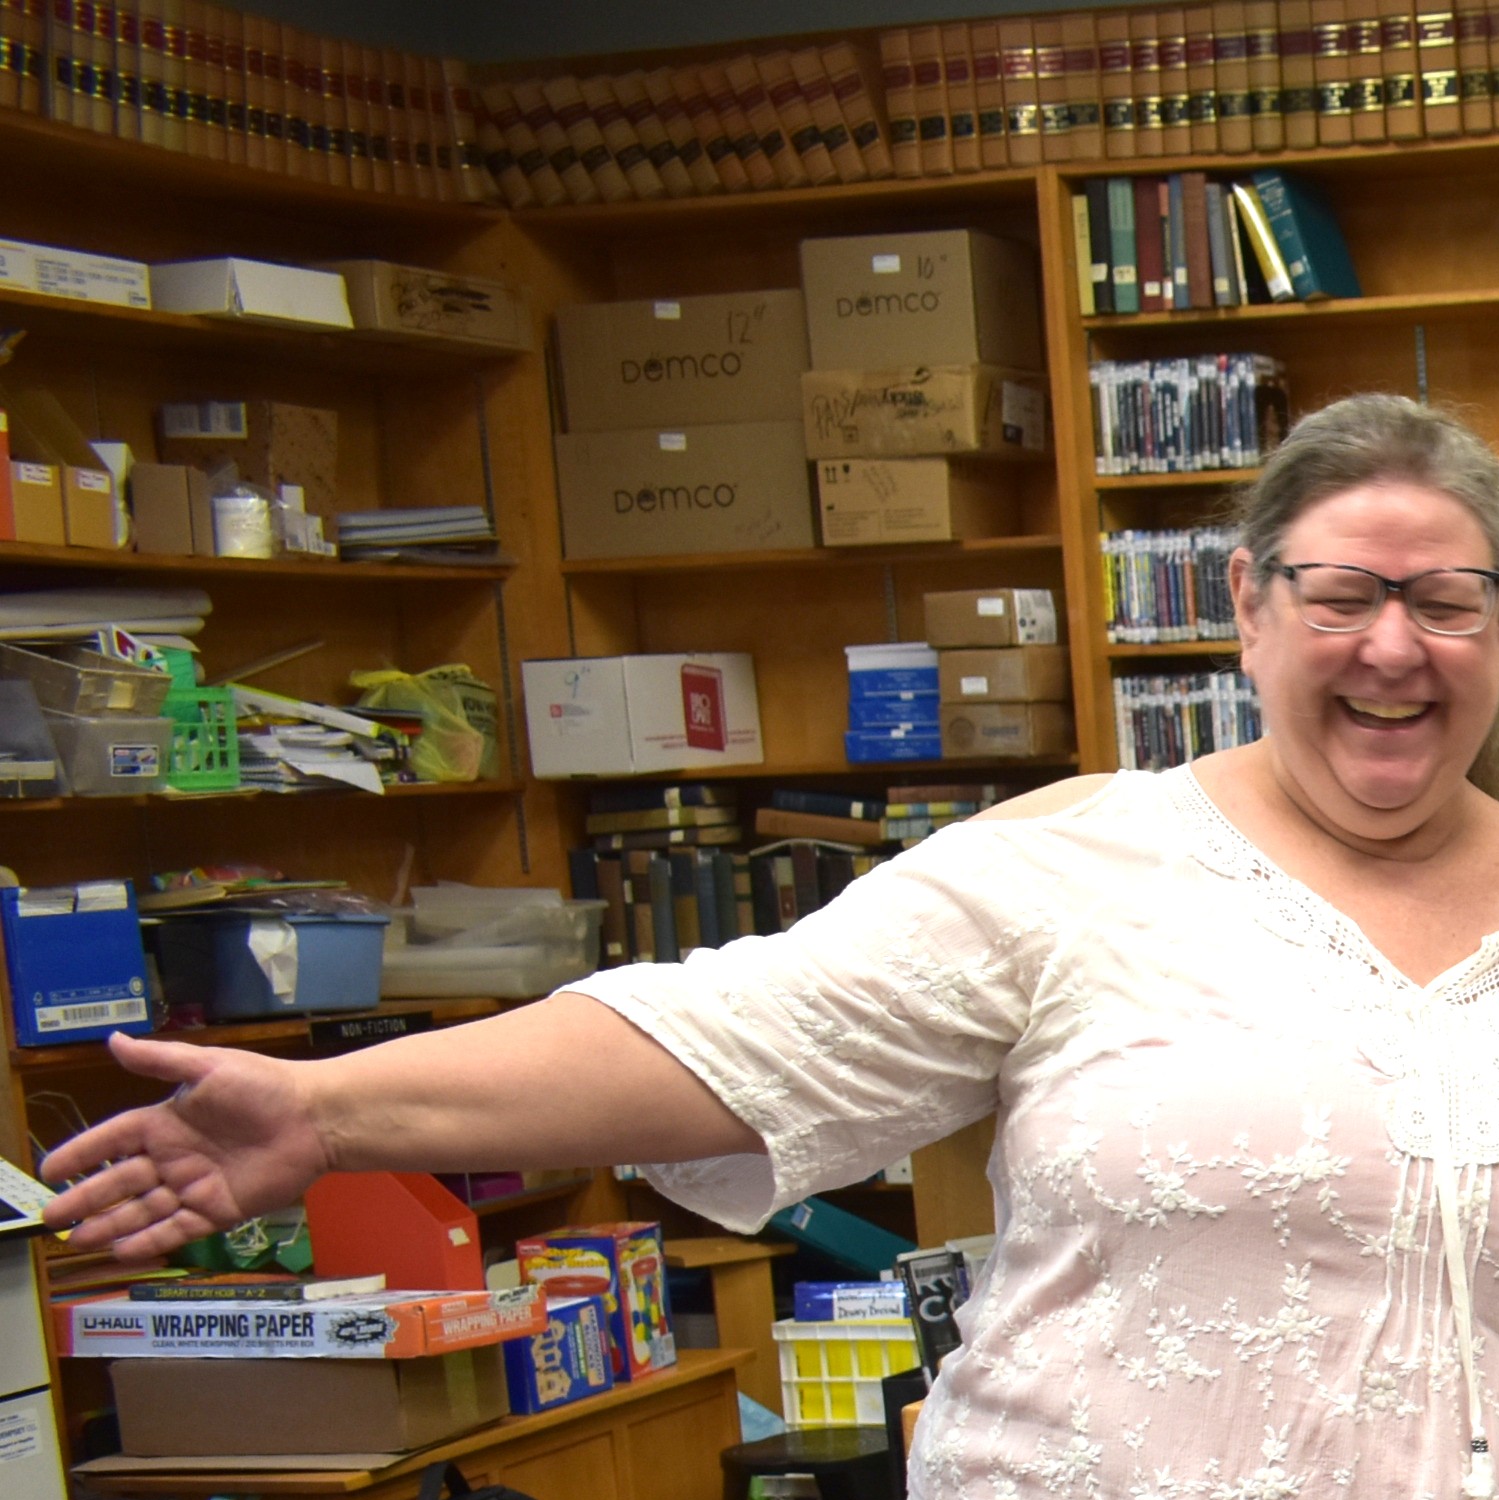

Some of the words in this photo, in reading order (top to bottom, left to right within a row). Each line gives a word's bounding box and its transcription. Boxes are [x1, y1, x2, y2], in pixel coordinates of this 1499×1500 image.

[341, 1018, 407, 1038] NON-FICTION
[155, 1288, 189, 1299] LIBRARY
[189, 1289, 213, 1298] STORY
[213, 1288, 236, 1298] HOUR
[838, 1306, 867, 1318] Dewey
[83, 1317, 144, 1330] U-HAUL
[152, 1313, 249, 1338] WRAPPING
[255, 1313, 314, 1338] PAPER
[443, 1311, 498, 1336] WRAPPING
[500, 1305, 533, 1323] PAPER
[178, 1340, 199, 1348] WHITE
[200, 1339, 240, 1348] NEWSPRINT
[285, 1340, 299, 1348] PER
[300, 1340, 315, 1348] BOX
